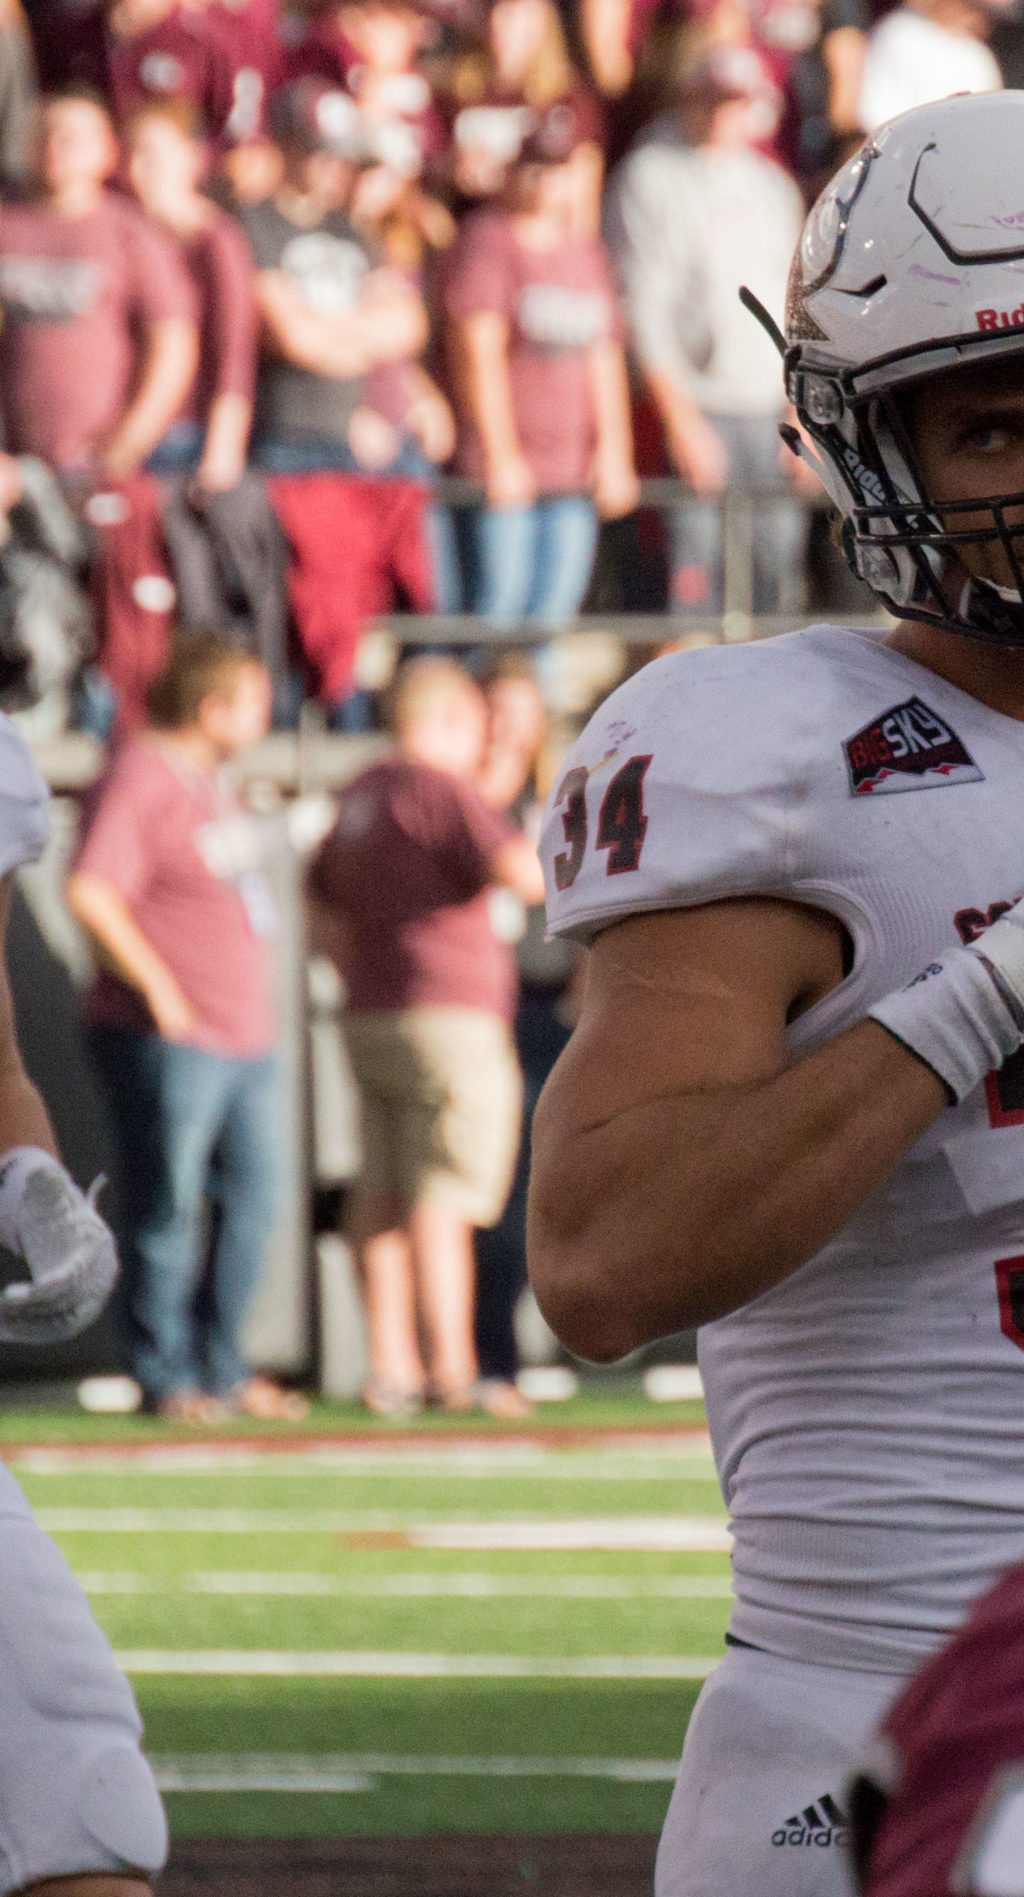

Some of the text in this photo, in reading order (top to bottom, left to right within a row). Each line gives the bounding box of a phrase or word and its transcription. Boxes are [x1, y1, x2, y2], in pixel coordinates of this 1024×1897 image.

[881, 703, 952, 758] SKY
[553, 754, 654, 892] 34
[770, 1827, 848, 1848] adid
